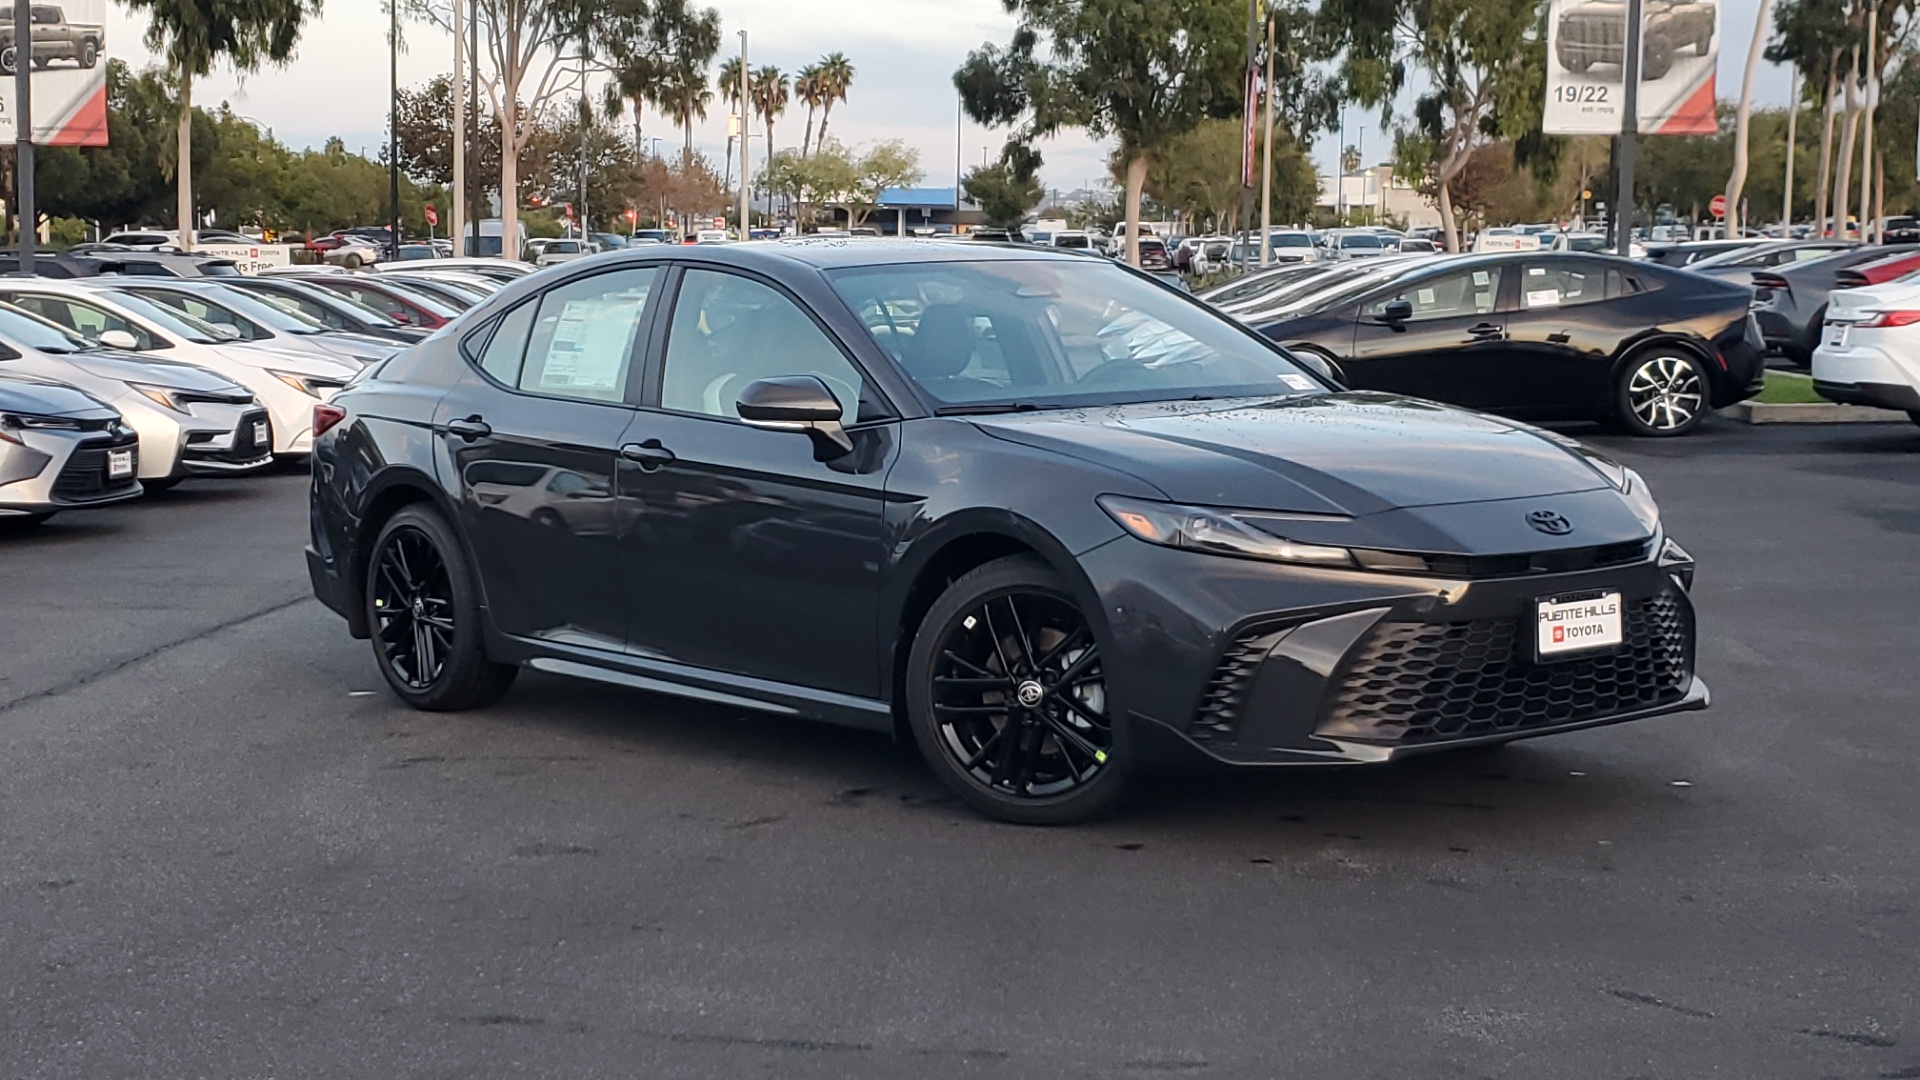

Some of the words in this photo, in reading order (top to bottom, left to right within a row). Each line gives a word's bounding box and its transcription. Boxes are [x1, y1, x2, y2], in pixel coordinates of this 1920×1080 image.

[1554, 85, 1608, 102] 19/22
[1540, 607, 1583, 623] PUENTE
[1584, 603, 1616, 618] HILLS
[1566, 624, 1603, 638] TOYOTA
